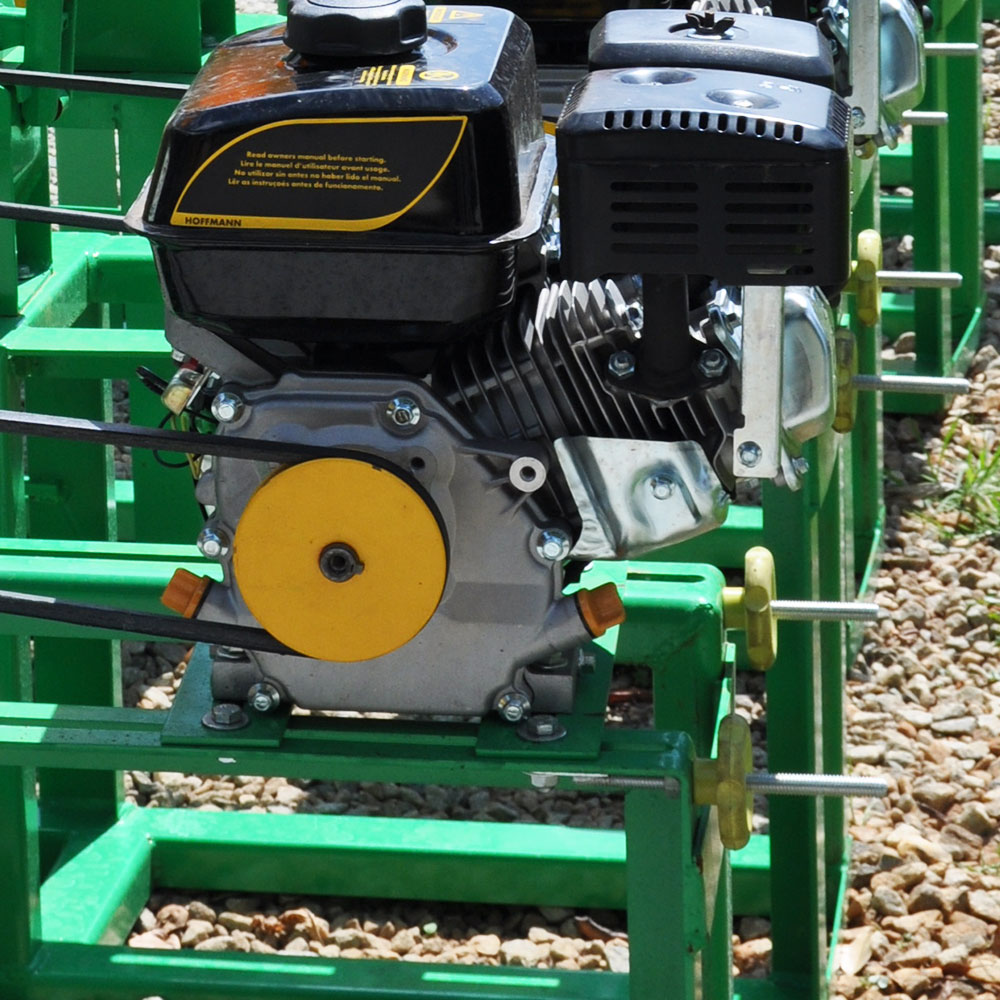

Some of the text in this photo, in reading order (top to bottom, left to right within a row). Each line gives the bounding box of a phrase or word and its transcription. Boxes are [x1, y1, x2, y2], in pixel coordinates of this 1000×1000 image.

[327, 154, 353, 162] before
[256, 160, 263, 168] le
[321, 172, 344, 180] haber
[184, 216, 242, 227] HOFFMANN
